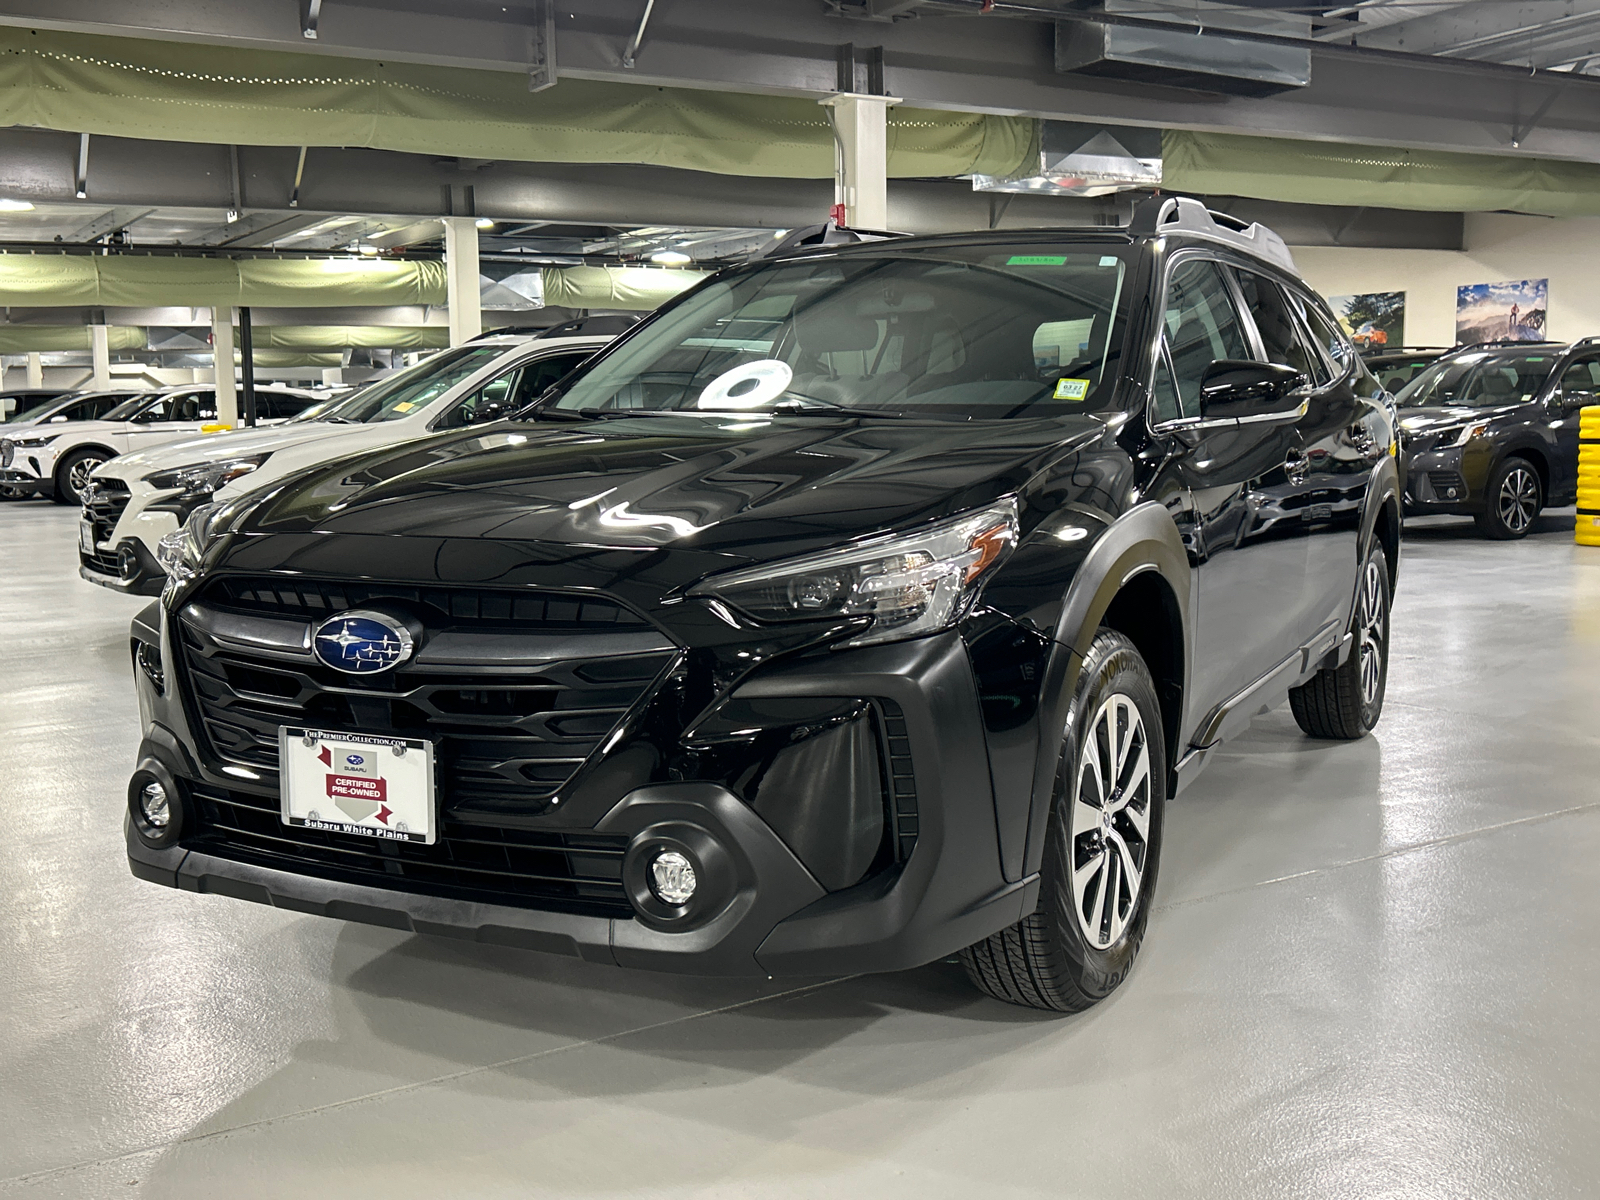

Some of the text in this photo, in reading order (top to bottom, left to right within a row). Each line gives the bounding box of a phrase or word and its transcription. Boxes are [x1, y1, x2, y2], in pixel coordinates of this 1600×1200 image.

[335, 778, 377, 789] CERTIFIED
[332, 786, 381, 798] PRE-OWNED
[304, 819, 409, 841] Subaru White Plains
